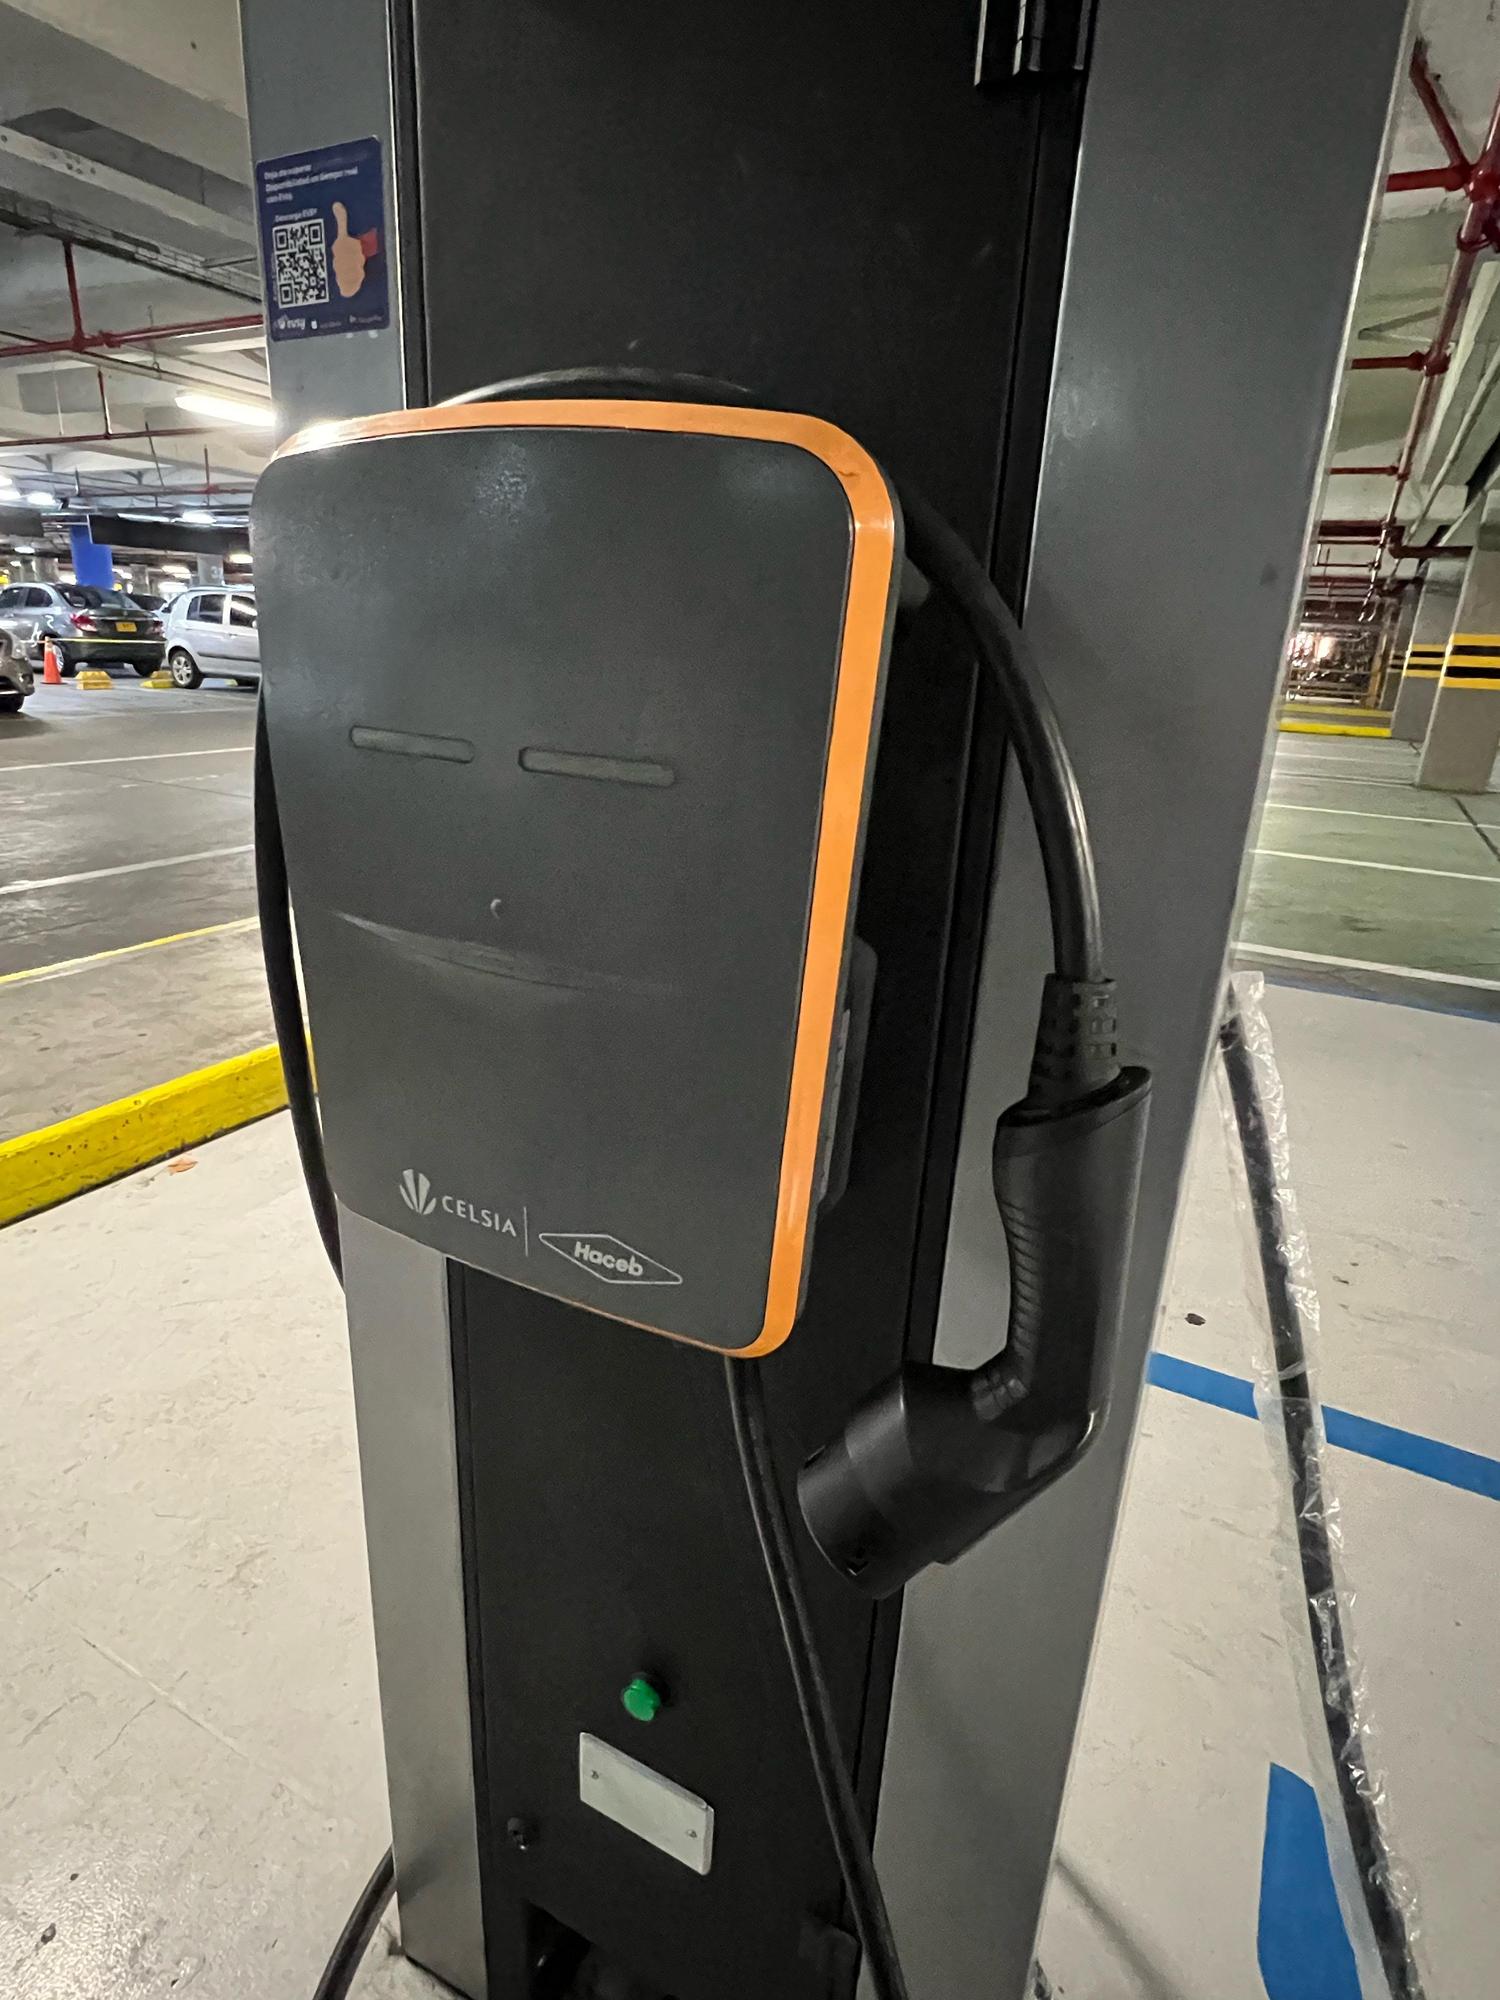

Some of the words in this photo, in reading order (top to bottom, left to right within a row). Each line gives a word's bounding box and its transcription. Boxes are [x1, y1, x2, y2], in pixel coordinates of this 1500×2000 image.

[320, 170, 343, 182] tiempo
[344, 166, 358, 176] real
[441, 1195, 518, 1238] CELSIA
[573, 1241, 645, 1277] Haceb
